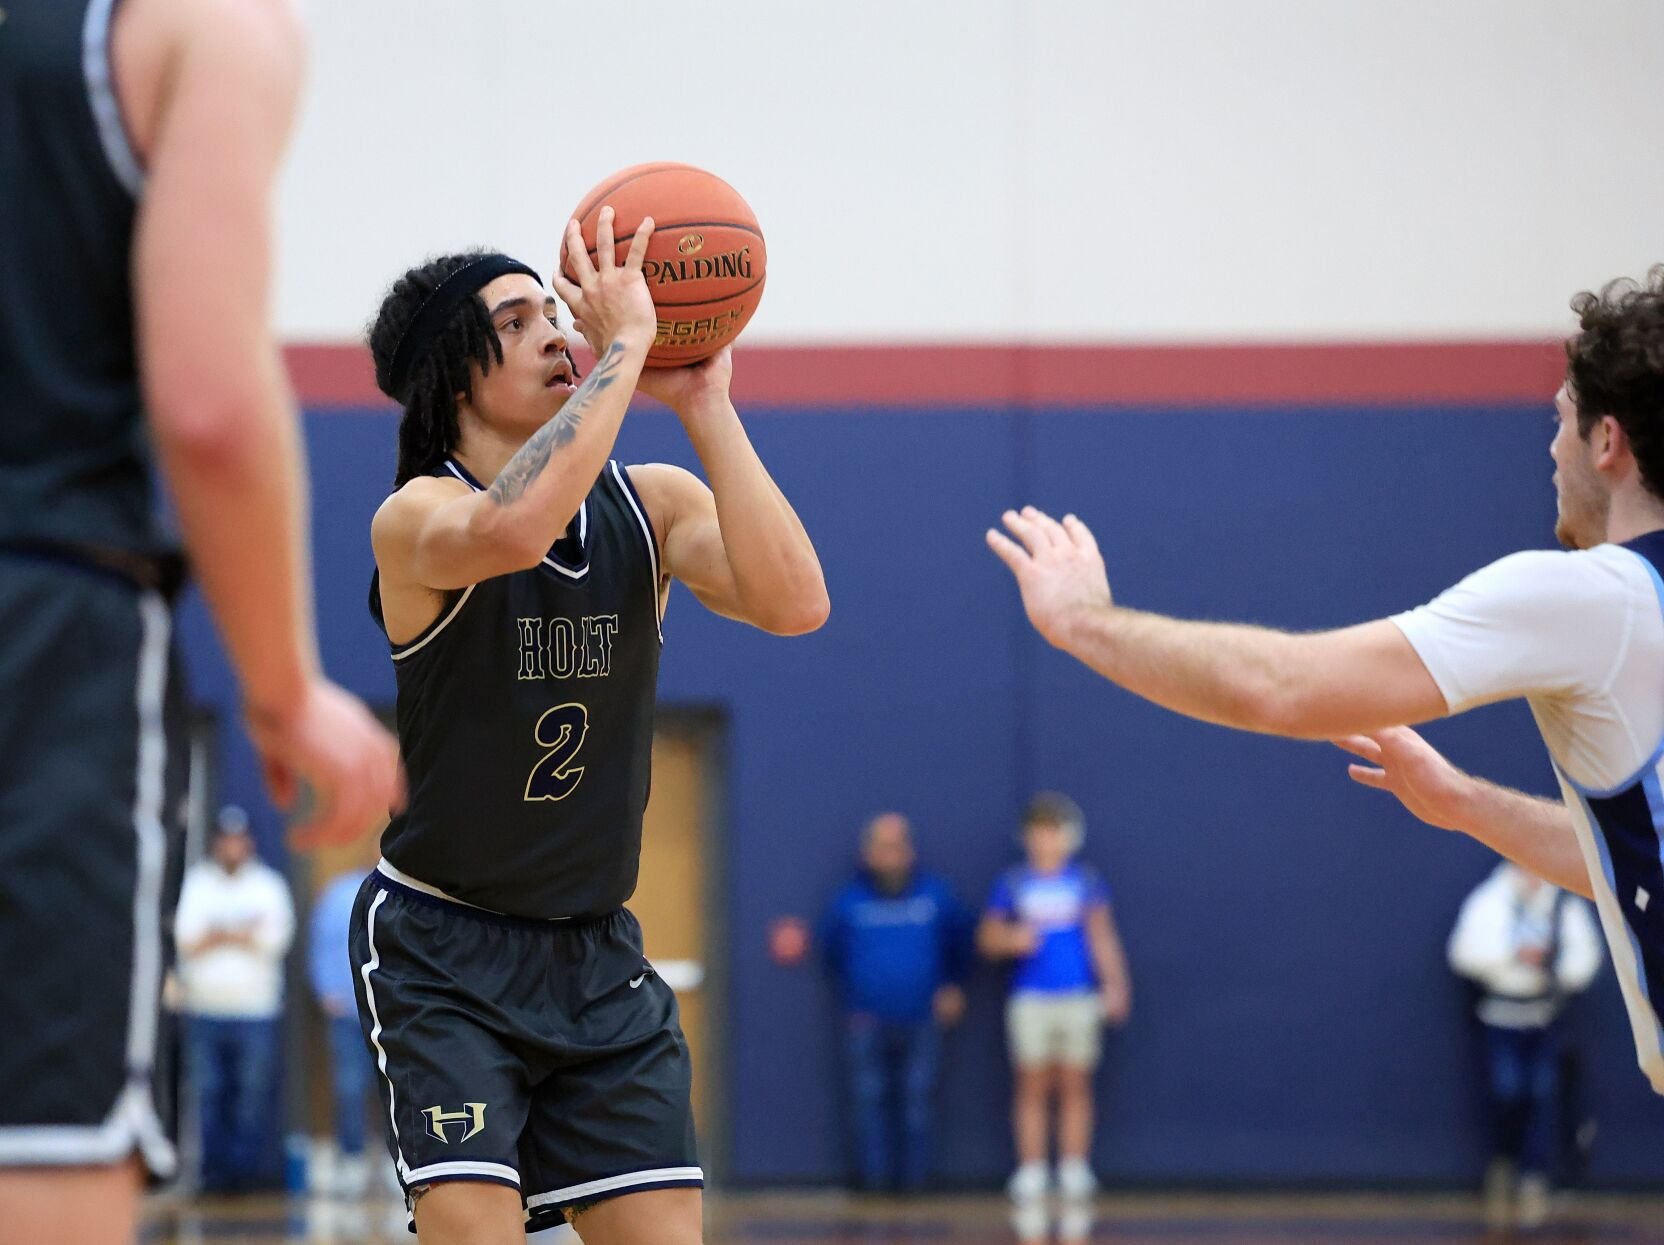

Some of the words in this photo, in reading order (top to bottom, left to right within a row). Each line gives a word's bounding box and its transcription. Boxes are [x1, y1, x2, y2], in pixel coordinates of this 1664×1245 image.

[641, 245, 752, 285] PALDING
[656, 303, 745, 337] EGACY
[517, 613, 619, 680] HOLT
[523, 702, 590, 802] 2
